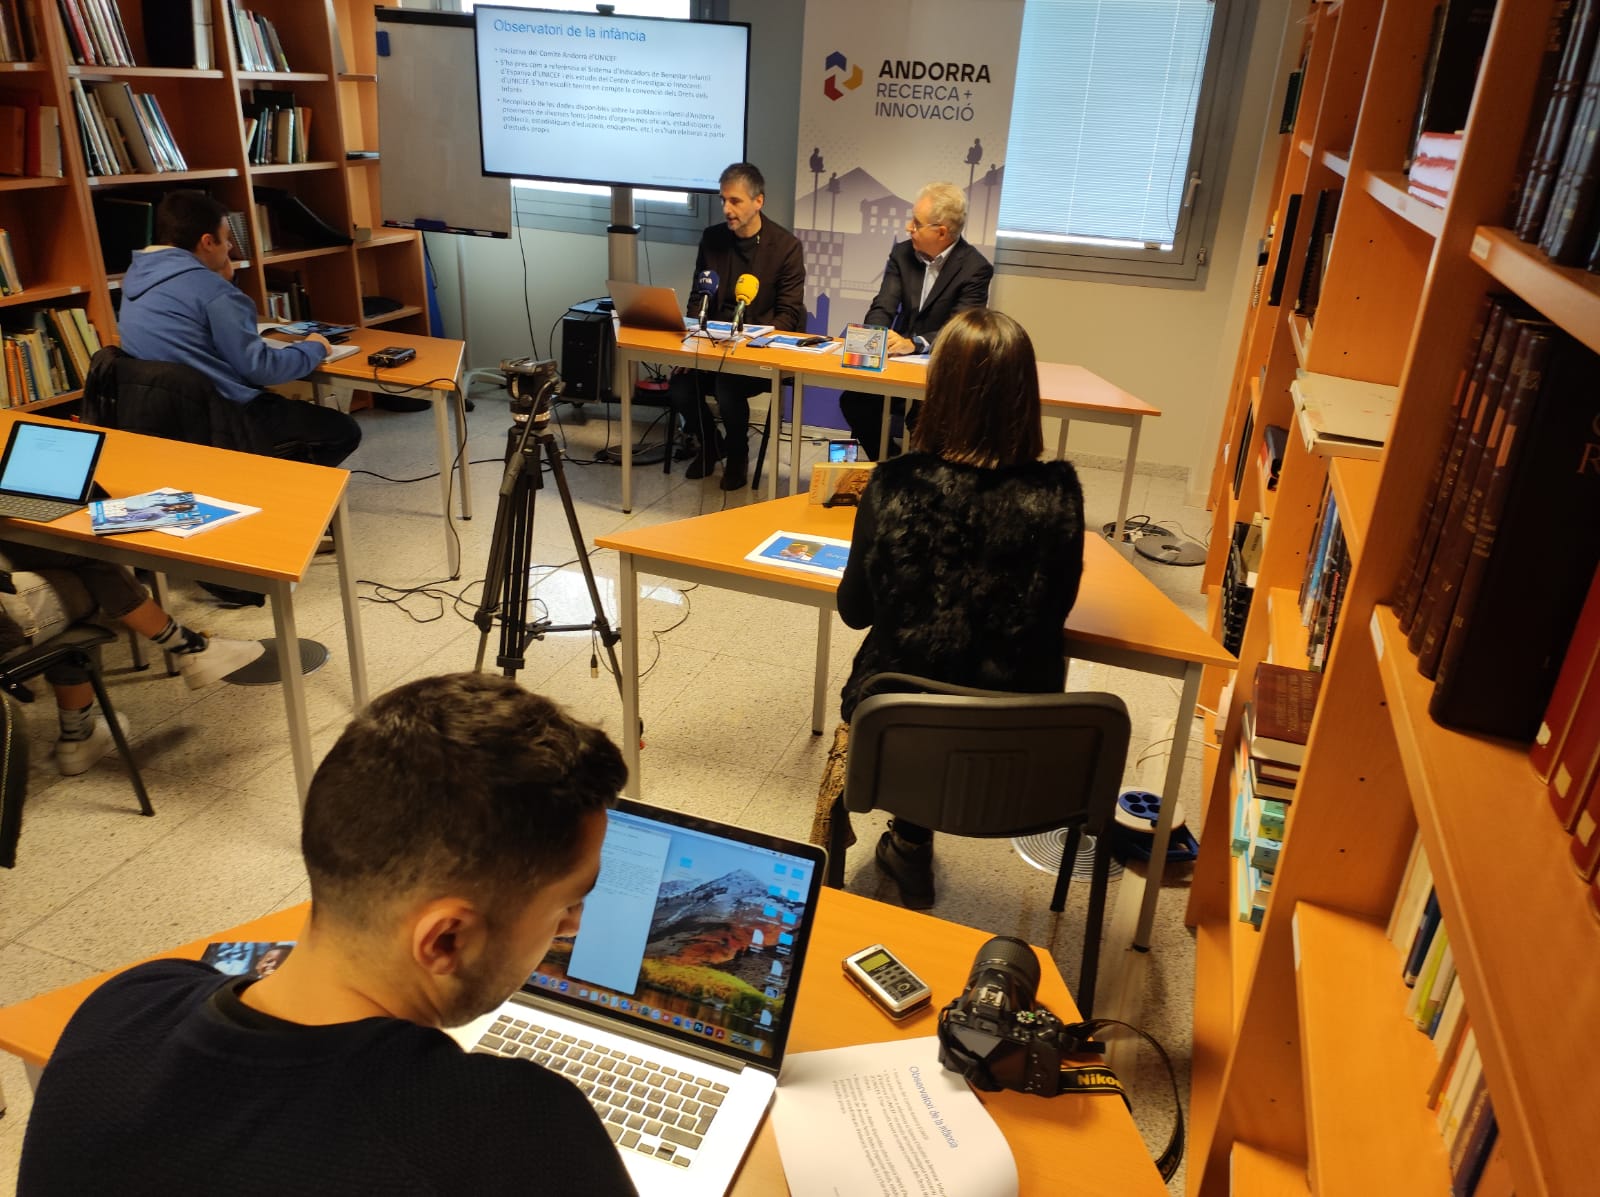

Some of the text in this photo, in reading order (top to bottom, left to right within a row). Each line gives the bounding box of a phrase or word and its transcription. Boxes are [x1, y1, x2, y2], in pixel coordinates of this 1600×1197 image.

[494, 18, 646, 42] Observatori de la infància
[562, 51, 588, 60] Andorra
[878, 59, 992, 84] ANDORRA
[876, 82, 960, 102] RECERCA
[875, 102, 975, 122] INNOVACIÓ
